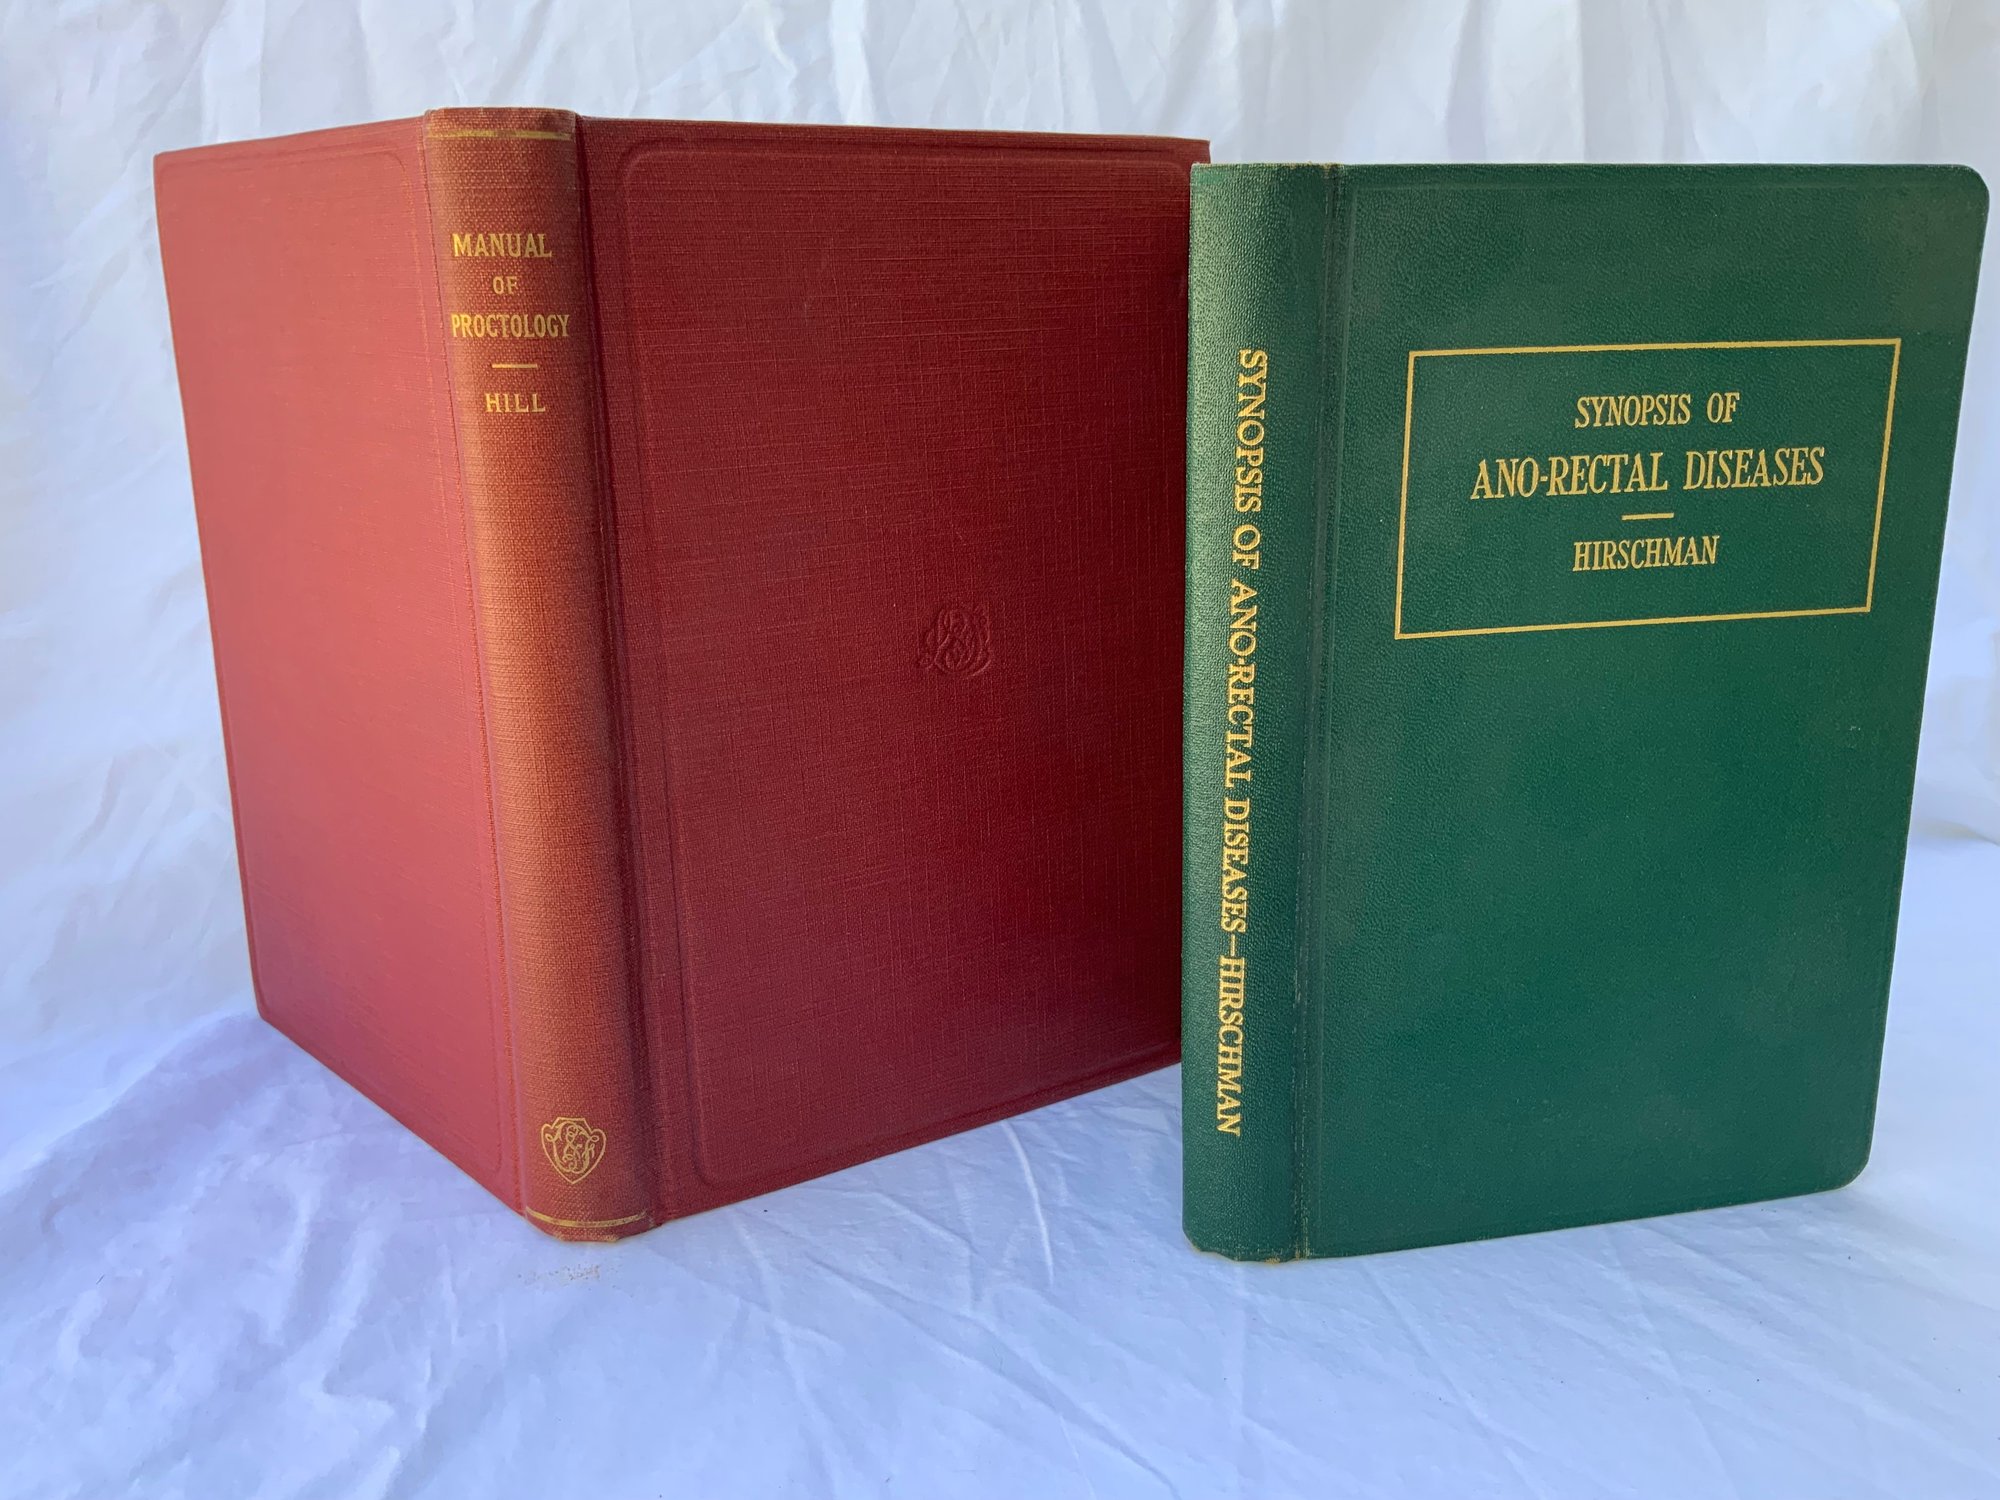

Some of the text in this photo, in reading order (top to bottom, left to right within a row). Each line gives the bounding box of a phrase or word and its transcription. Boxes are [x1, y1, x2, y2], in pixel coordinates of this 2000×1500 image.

[452, 233, 552, 257] MANUAL
[492, 276, 518, 294] OF
[452, 314, 570, 338] PROCTOLOGY
[485, 393, 546, 413] HILL
[1574, 392, 1740, 428] SYNOPSIS OF
[1236, 349, 1268, 513] SYNOPSIS
[1470, 446, 1825, 500] ANO-RECTAL DISEASES
[1232, 525, 1262, 569] OF
[1572, 535, 1720, 572] HIRSCHMAN
[1225, 580, 1257, 788] ANO-RECTAL
